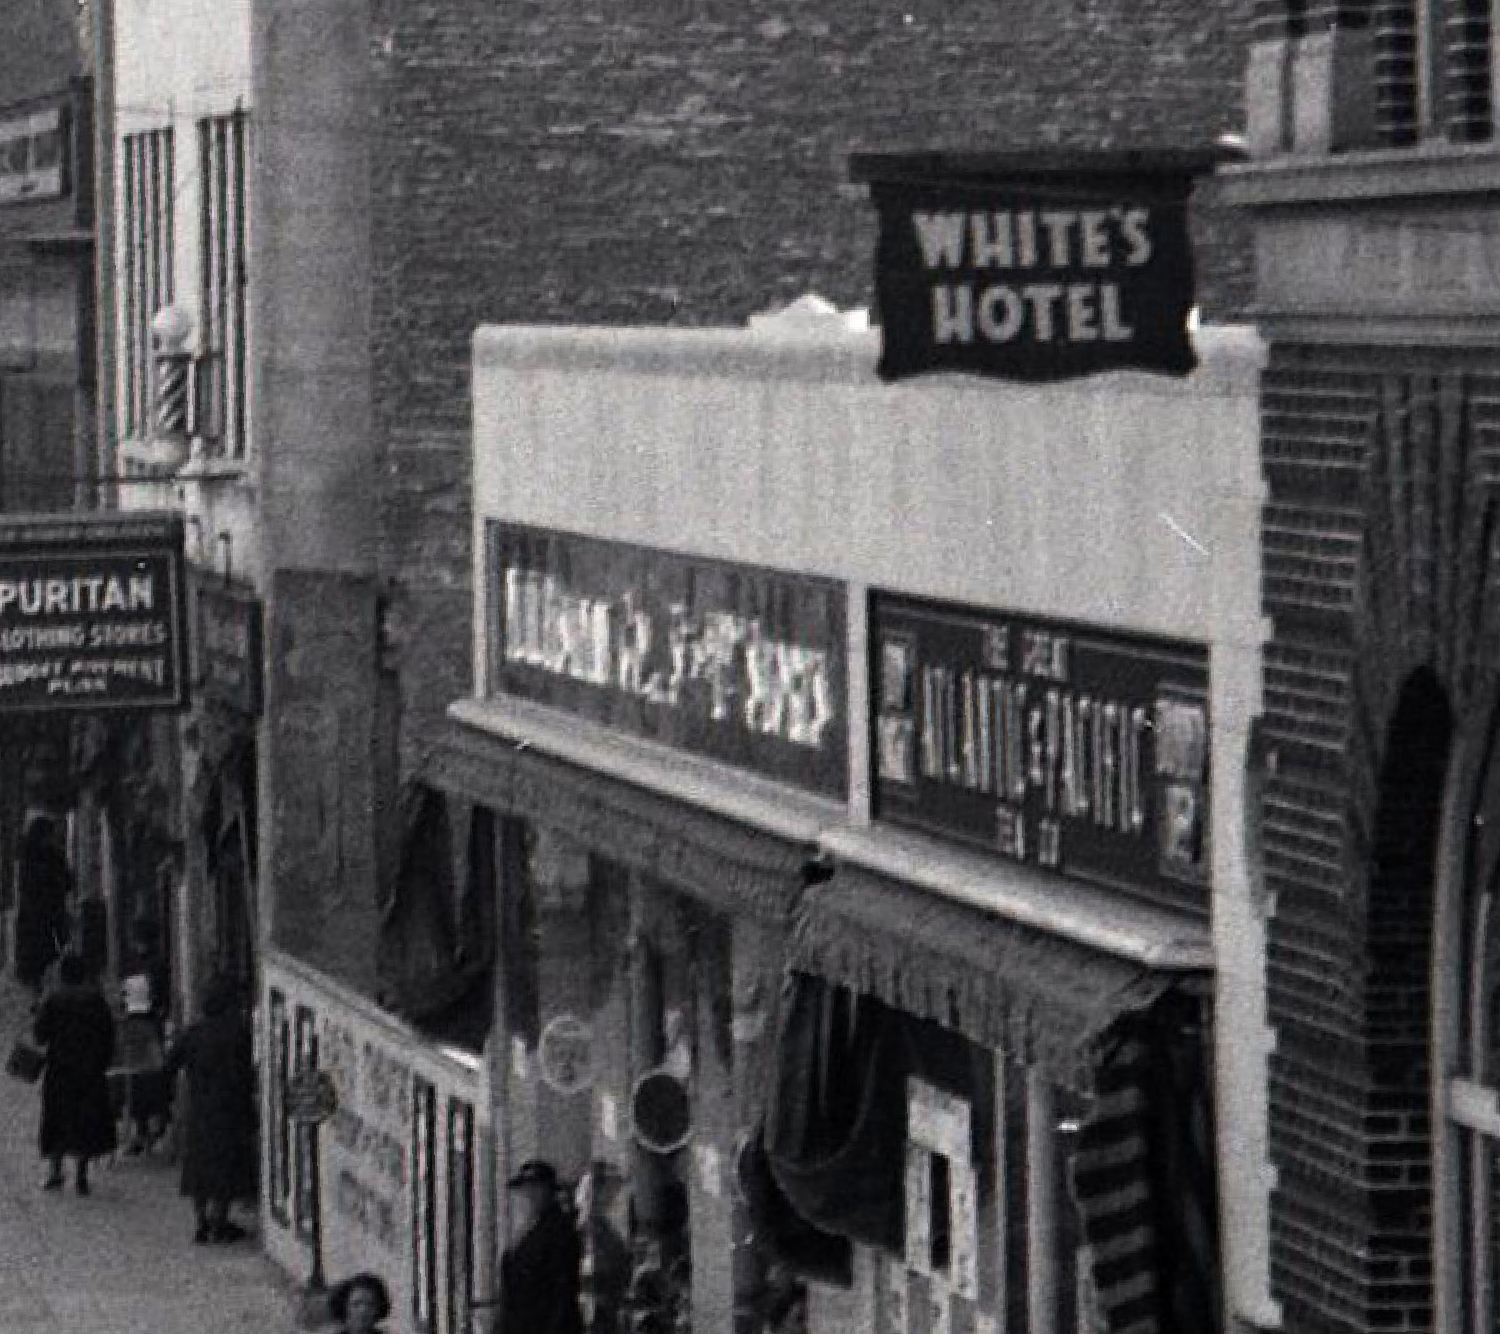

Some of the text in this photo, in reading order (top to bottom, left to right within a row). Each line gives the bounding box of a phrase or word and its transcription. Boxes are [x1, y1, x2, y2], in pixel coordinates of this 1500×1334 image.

[911, 207, 1152, 269] WHITE'S
[931, 283, 1135, 344] HOTEL
[90, 621, 168, 648] STORES
